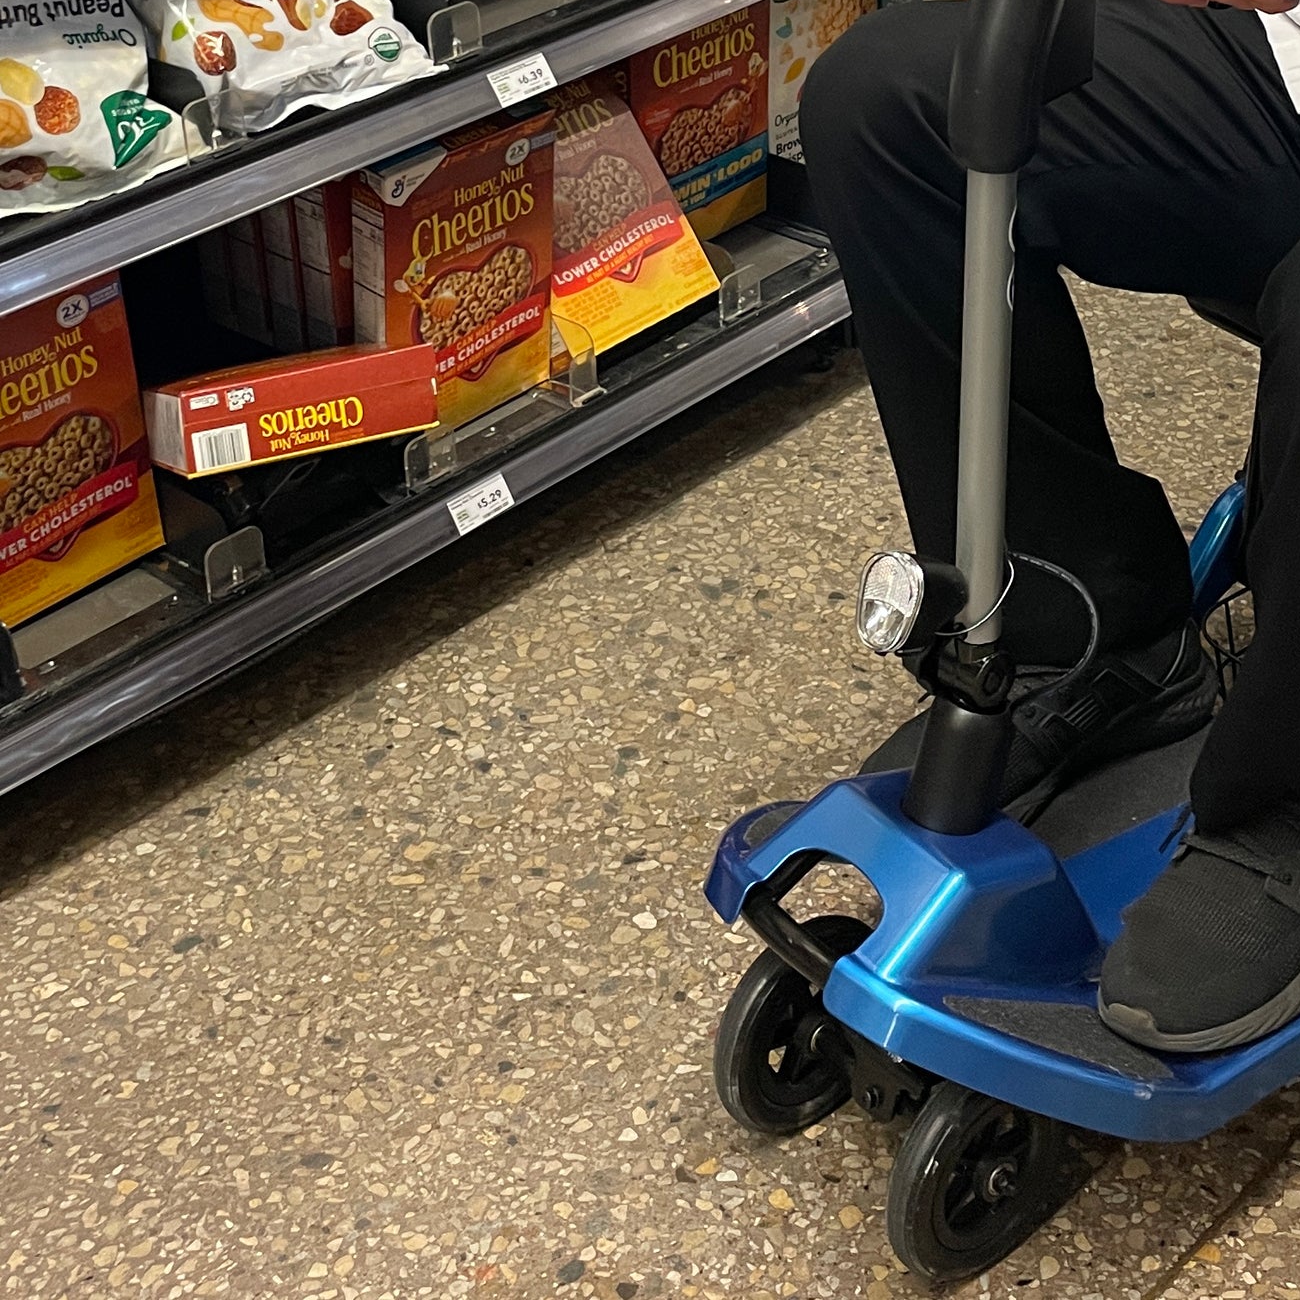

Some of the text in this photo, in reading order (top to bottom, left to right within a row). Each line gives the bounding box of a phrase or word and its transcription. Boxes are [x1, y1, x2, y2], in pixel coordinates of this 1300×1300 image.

[63, 25, 136, 48] Organic
[654, 23, 755, 87] Cheerios
[518, 69, 543, 85] $6.39
[509, 143, 526, 158] 2X
[455, 178, 497, 207] Honey
[500, 163, 524, 187] Nut
[674, 174, 711, 200] WIN
[412, 183, 534, 259] Cheerios
[554, 255, 600, 285] LOWER
[600, 214, 674, 262] CHOLESTEROL
[61, 301, 83, 319] 2X
[1, 327, 83, 377] Honey Nut
[458, 306, 540, 361] CHOLESTEROL
[259, 396, 364, 437] Cheerios
[270, 438, 292, 452] Nut
[30, 475, 132, 542] CHOLESTEROL
[478, 490, 501, 508] $5.29
